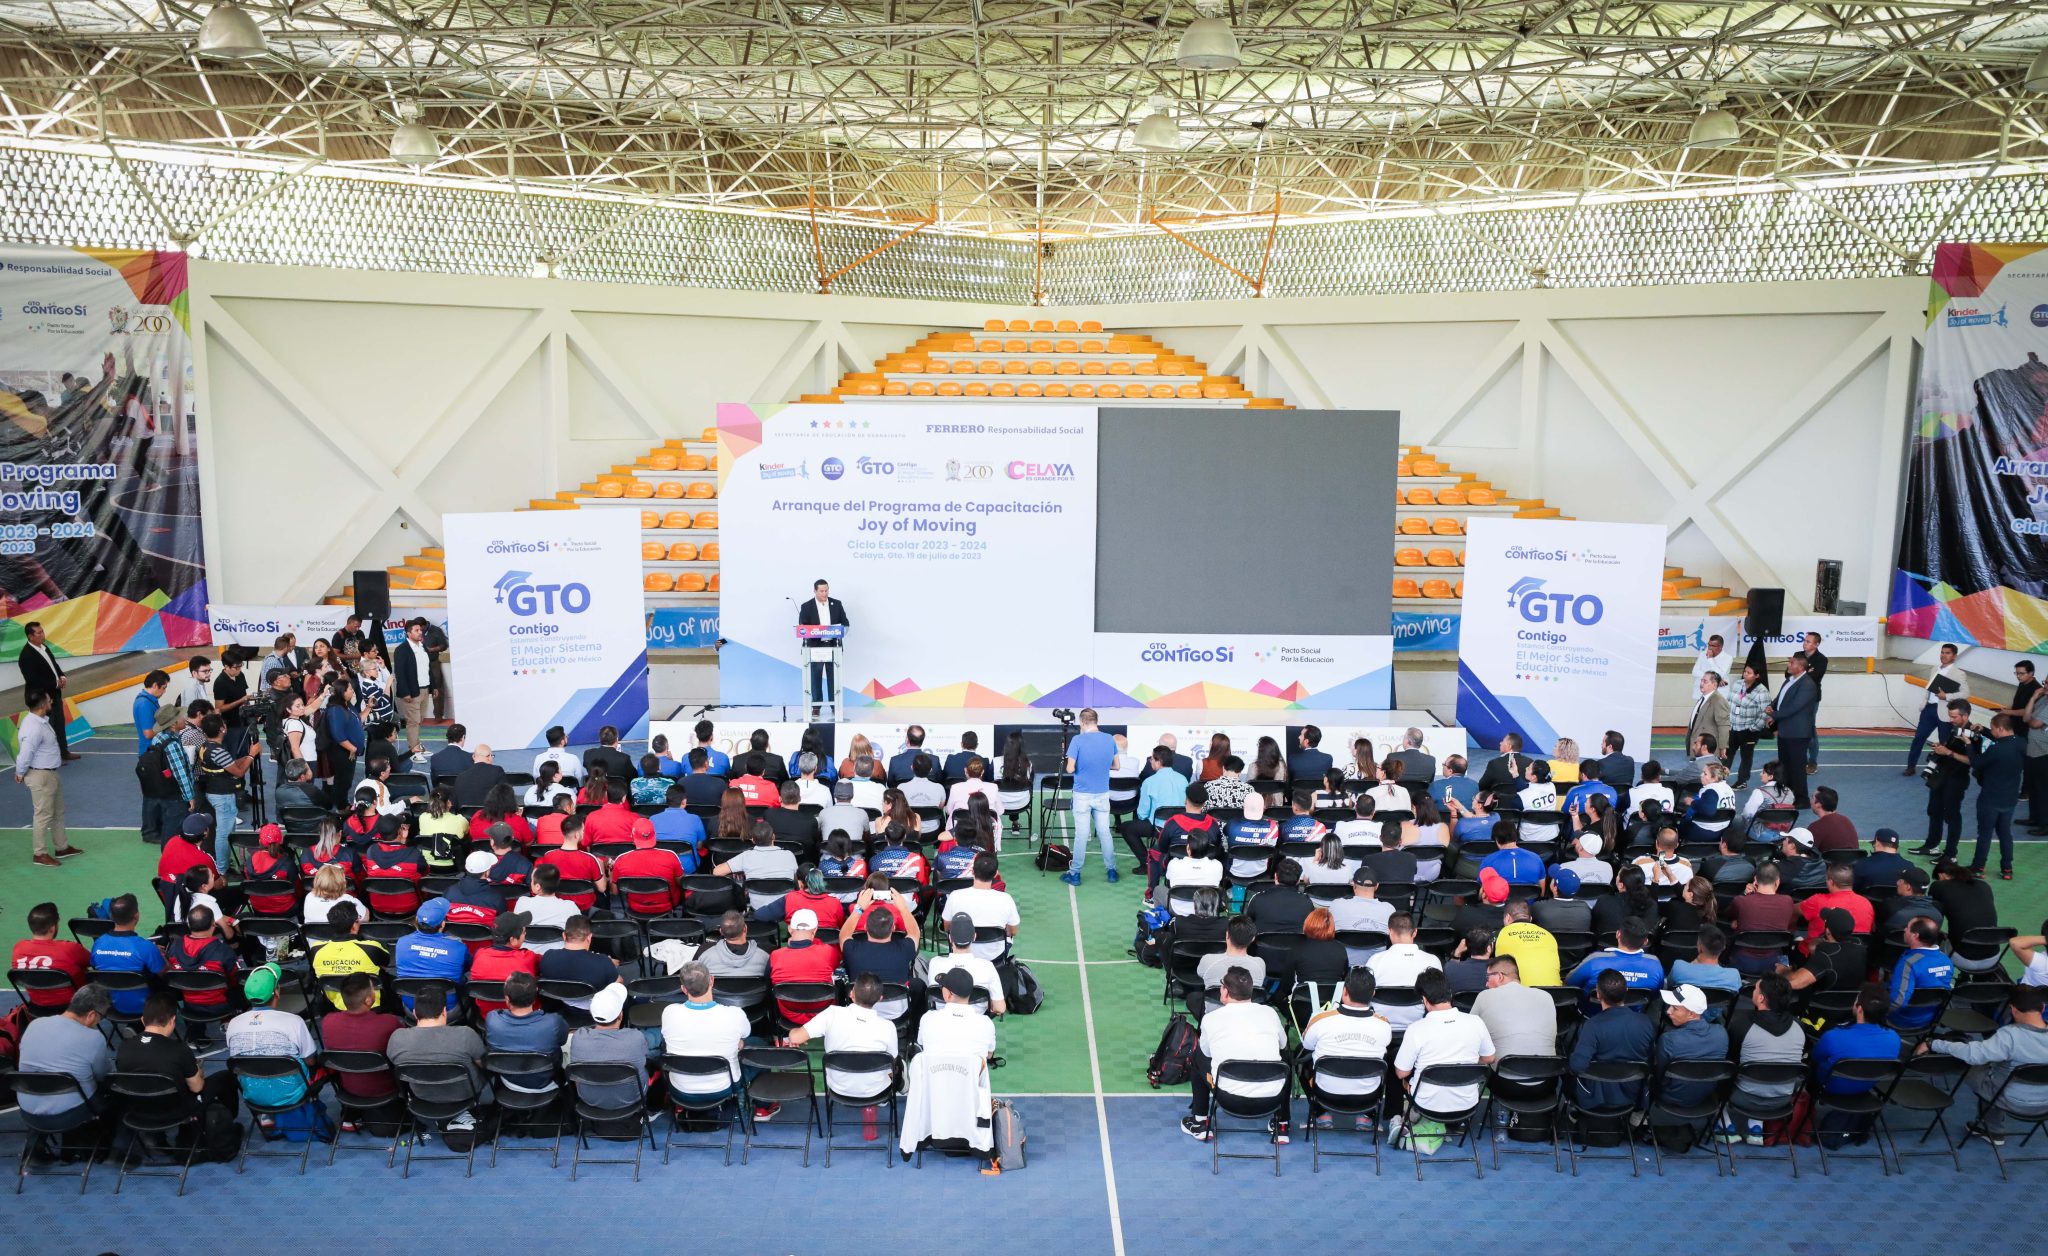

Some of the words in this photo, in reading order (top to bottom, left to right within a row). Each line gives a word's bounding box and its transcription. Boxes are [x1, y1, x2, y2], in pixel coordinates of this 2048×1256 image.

[7, 263, 84, 275] Responsabilidad
[85, 267, 112, 276] Social
[133, 315, 171, 332] 200
[926, 424, 985, 433] FERRERO
[988, 425, 1057, 434] Responsabilidad
[1059, 426, 1084, 434] Social
[2, 464, 116, 484] Programa
[861, 461, 894, 475] GTO
[963, 465, 994, 479] 200
[1004, 460, 1074, 480] CELAYA
[0, 488, 80, 513] oving
[772, 500, 840, 514] Arranque
[843, 500, 865, 511] del
[868, 501, 941, 515] Programa
[944, 501, 962, 512] de
[965, 501, 1062, 516] Capacitación
[0, 525, 37, 539] 2023
[52, 523, 94, 538] 2024
[858, 518, 888, 535] Joy
[892, 518, 909, 531] of
[913, 518, 977, 536] Moving
[2, 542, 35, 553] 2023
[486, 541, 536, 554] CONTIGO
[847, 540, 876, 550] Ciclo
[878, 540, 919, 550] Escolar
[922, 541, 949, 550] 2023
[960, 541, 987, 550] 2024
[929, 552, 948, 561] julio
[1505, 548, 1554, 561] CONTIGO
[507, 582, 591, 616] GTO
[1519, 591, 1604, 626] GTO
[382, 618, 407, 630] Kind
[509, 623, 559, 636] Contigo
[679, 617, 696, 636] of
[1393, 617, 1451, 639] moving
[1517, 630, 1567, 645] Contigo
[511, 646, 522, 656] El
[524, 644, 556, 657] Mejor
[559, 642, 602, 653] Sistema
[1141, 645, 1213, 663] CONTIGO
[1546, 644, 1594, 653] Construyendo
[511, 655, 566, 666] Educativo
[577, 655, 602, 663] México
[1516, 651, 1527, 660] El
[1529, 652, 1562, 664] Mejor
[1564, 653, 1609, 666] Sistema
[1515, 661, 1570, 674] Educativo
[1582, 668, 1607, 677] México
[1532, 793, 1555, 808] GTO
[96, 949, 131, 957] Guanajuato
